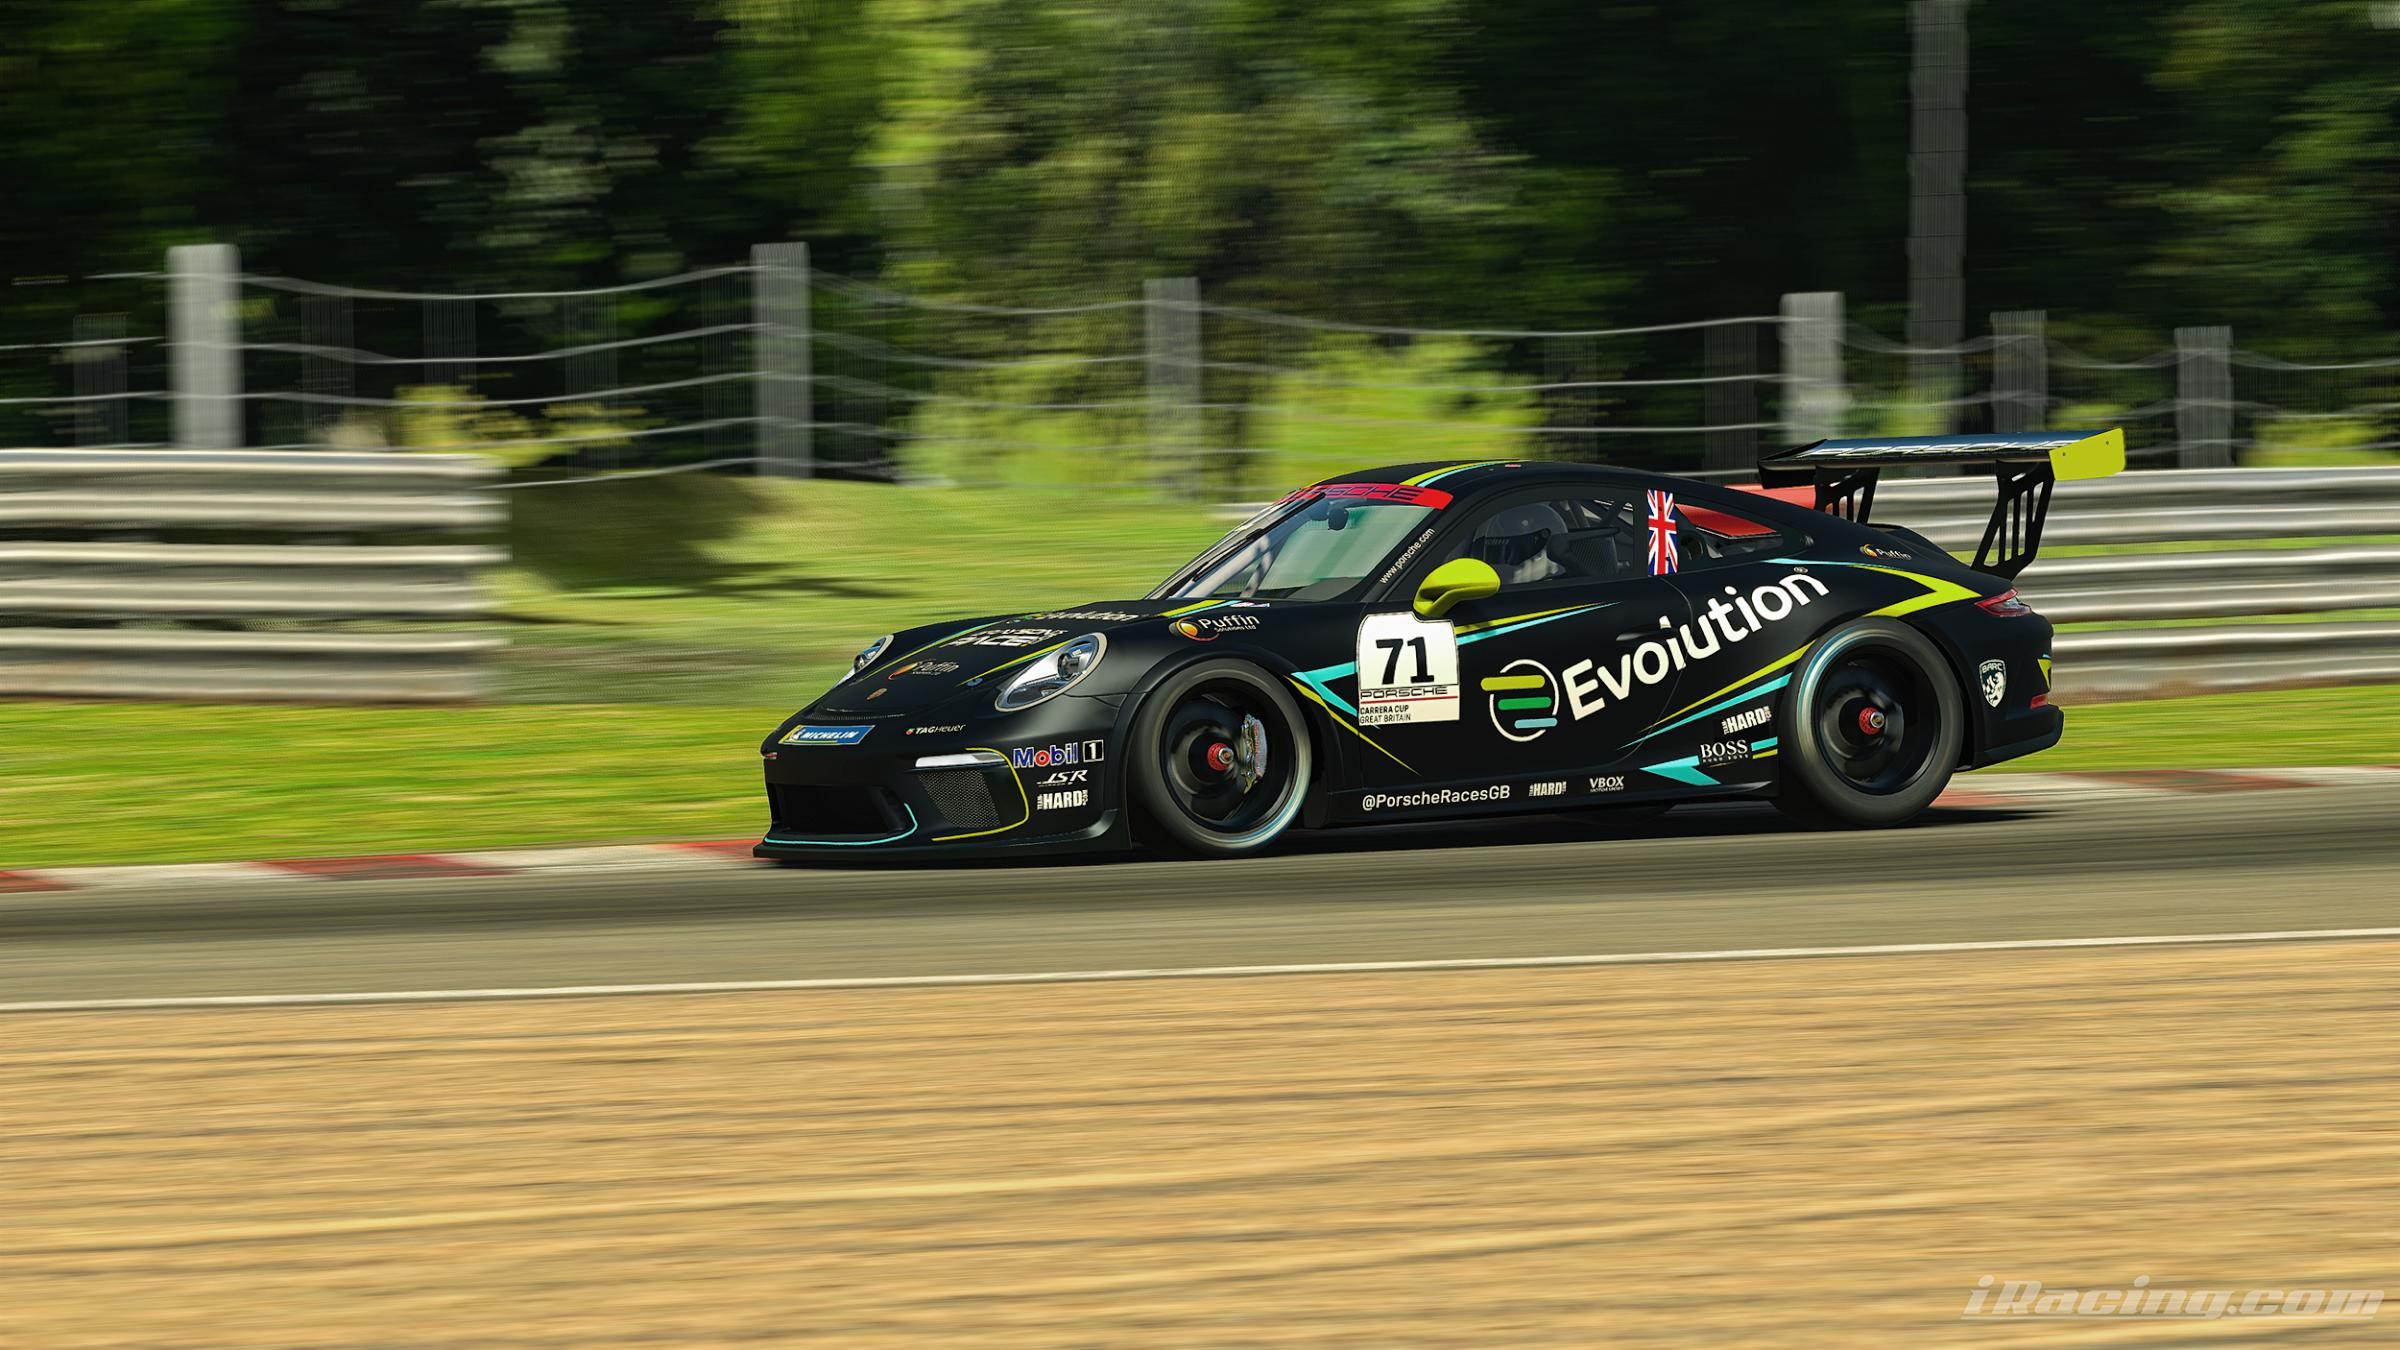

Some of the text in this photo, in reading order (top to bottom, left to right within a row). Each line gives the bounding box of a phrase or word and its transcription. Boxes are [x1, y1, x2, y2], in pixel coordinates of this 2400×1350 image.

[1379, 528, 1436, 584] www.porsche.com
[1198, 614, 1260, 629] Puffin
[1562, 573, 1830, 721] Evolution
[1375, 636, 1435, 685] 71
[1982, 662, 2004, 674] BARC
[1360, 686, 1448, 700] PORSCHE
[1360, 704, 1410, 715] CARRERA CUP
[1360, 713, 1411, 724] GREAT BRITAIN
[1726, 707, 1767, 734] HARD
[802, 730, 860, 740] MICHELIN
[1013, 742, 1079, 769] Mobil
[1700, 739, 1749, 758] BOSS
[1533, 782, 1563, 797] HARD
[1589, 776, 1625, 789] VBOX
[1042, 790, 1083, 810] HARD
[1362, 785, 1511, 811] @PorscheRacesGB
